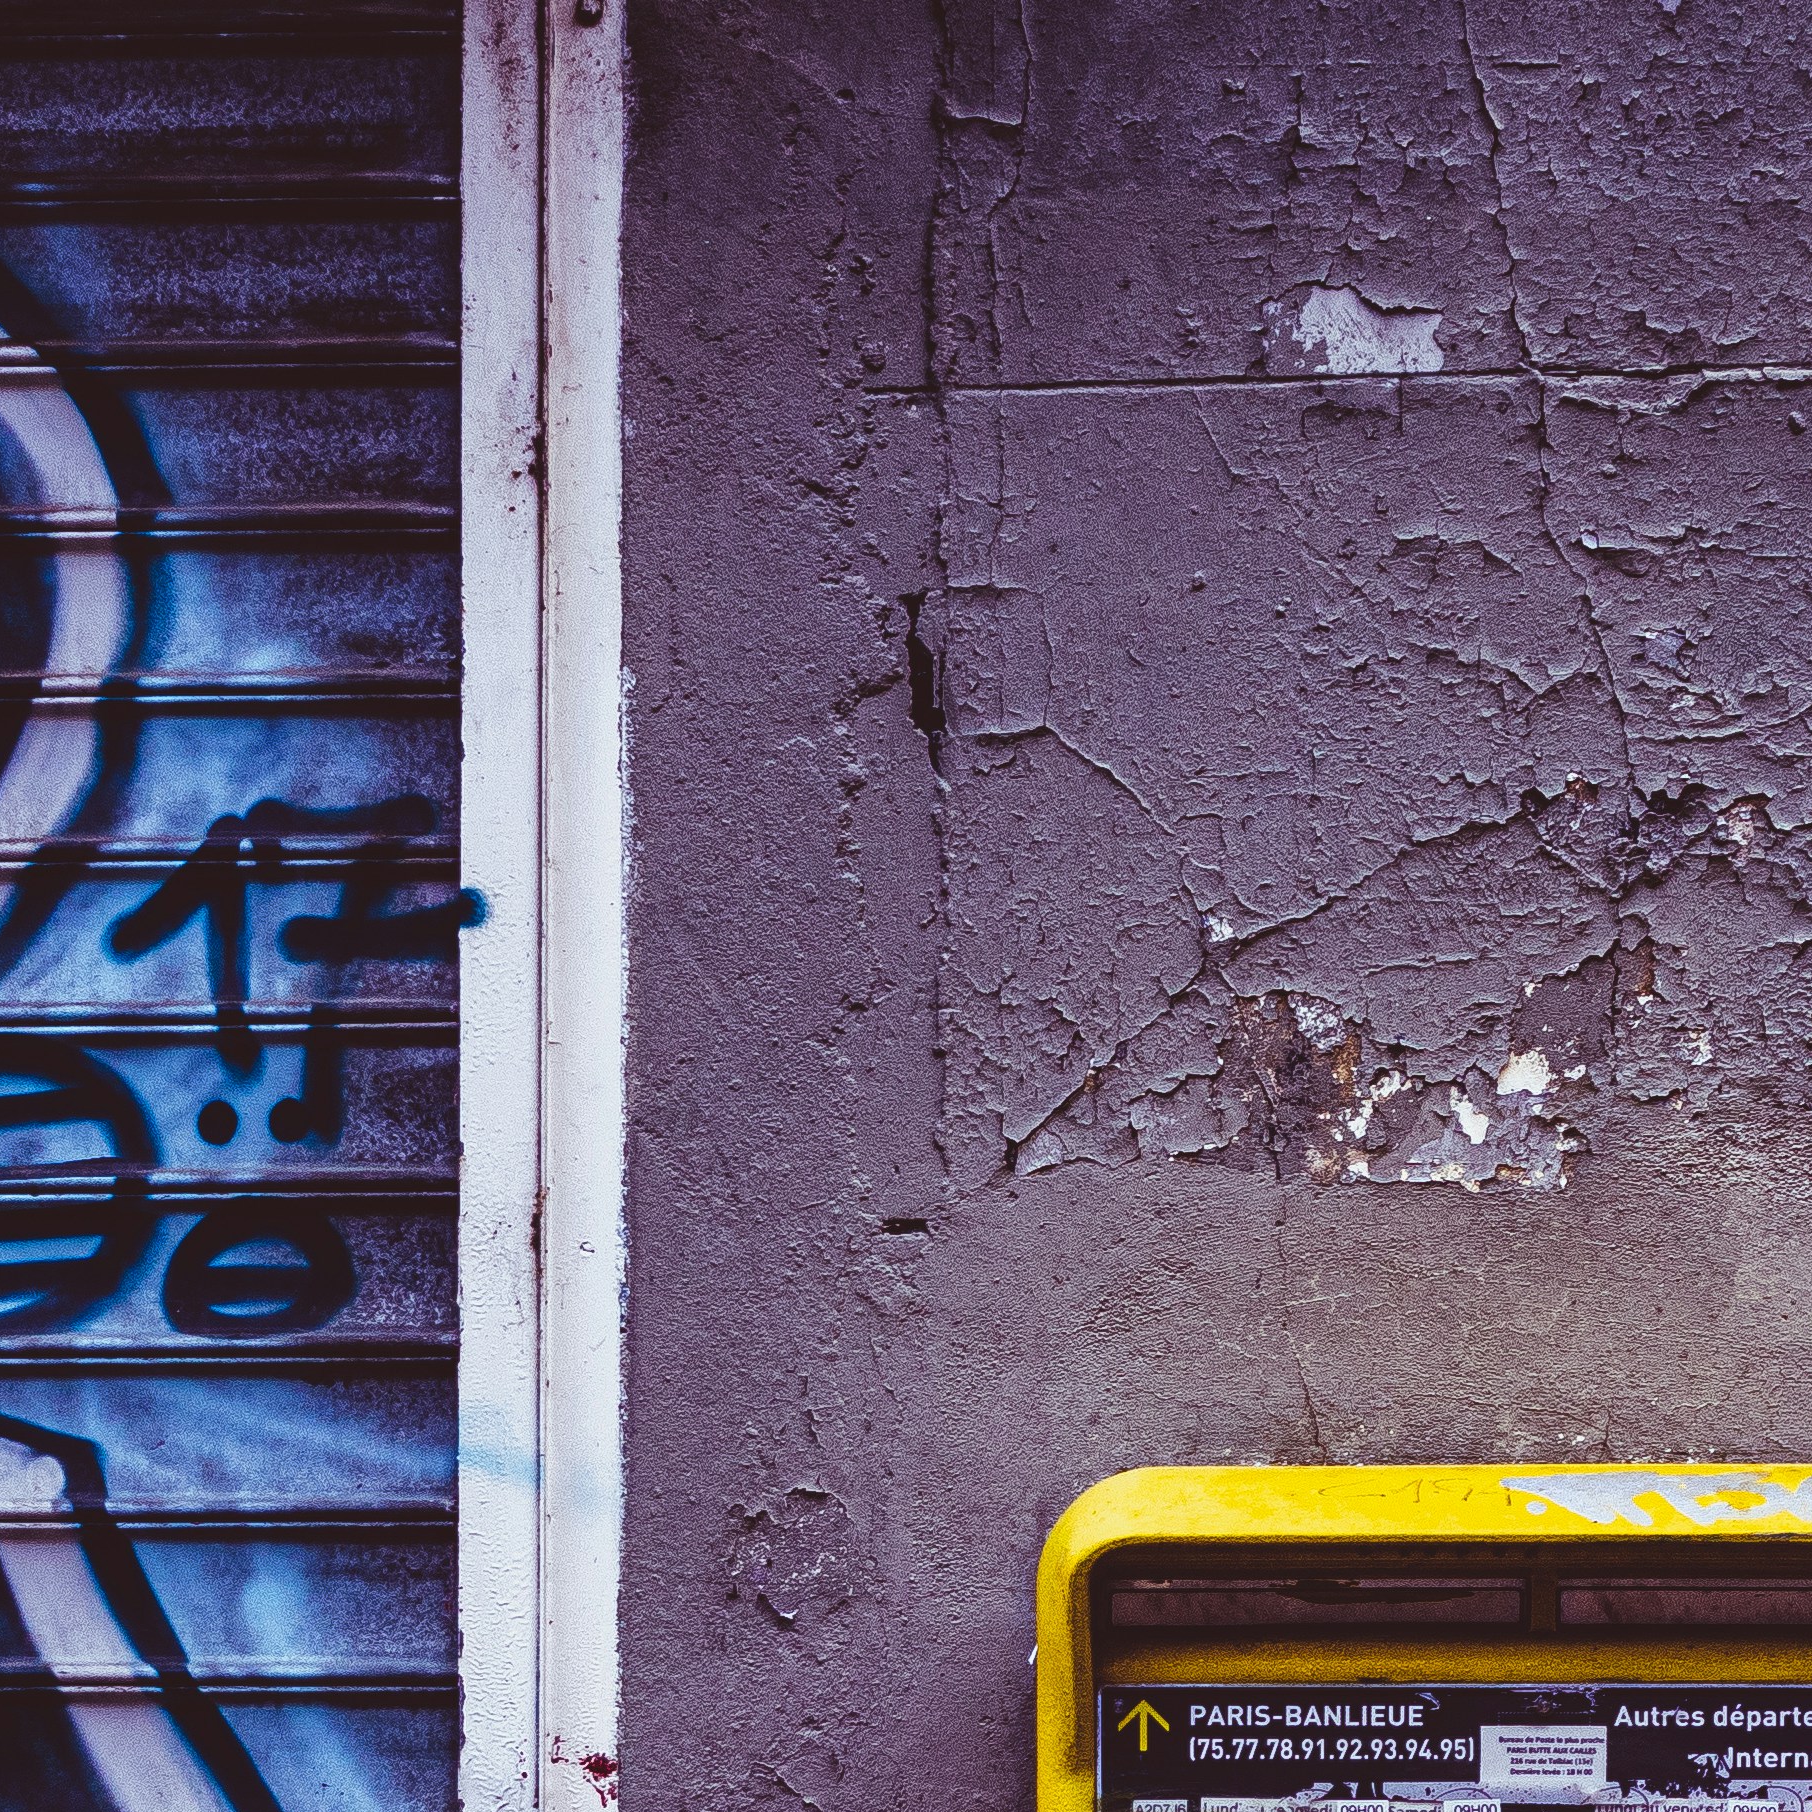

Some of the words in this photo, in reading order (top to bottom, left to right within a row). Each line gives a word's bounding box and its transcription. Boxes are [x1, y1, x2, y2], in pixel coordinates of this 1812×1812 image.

[1189, 1705, 1424, 1727] PARIS-BANLIEUE
[1614, 1705, 1705, 1727] Autres
[1189, 1736, 1475, 1761] (75.77.78.91.92.93.94.95)
